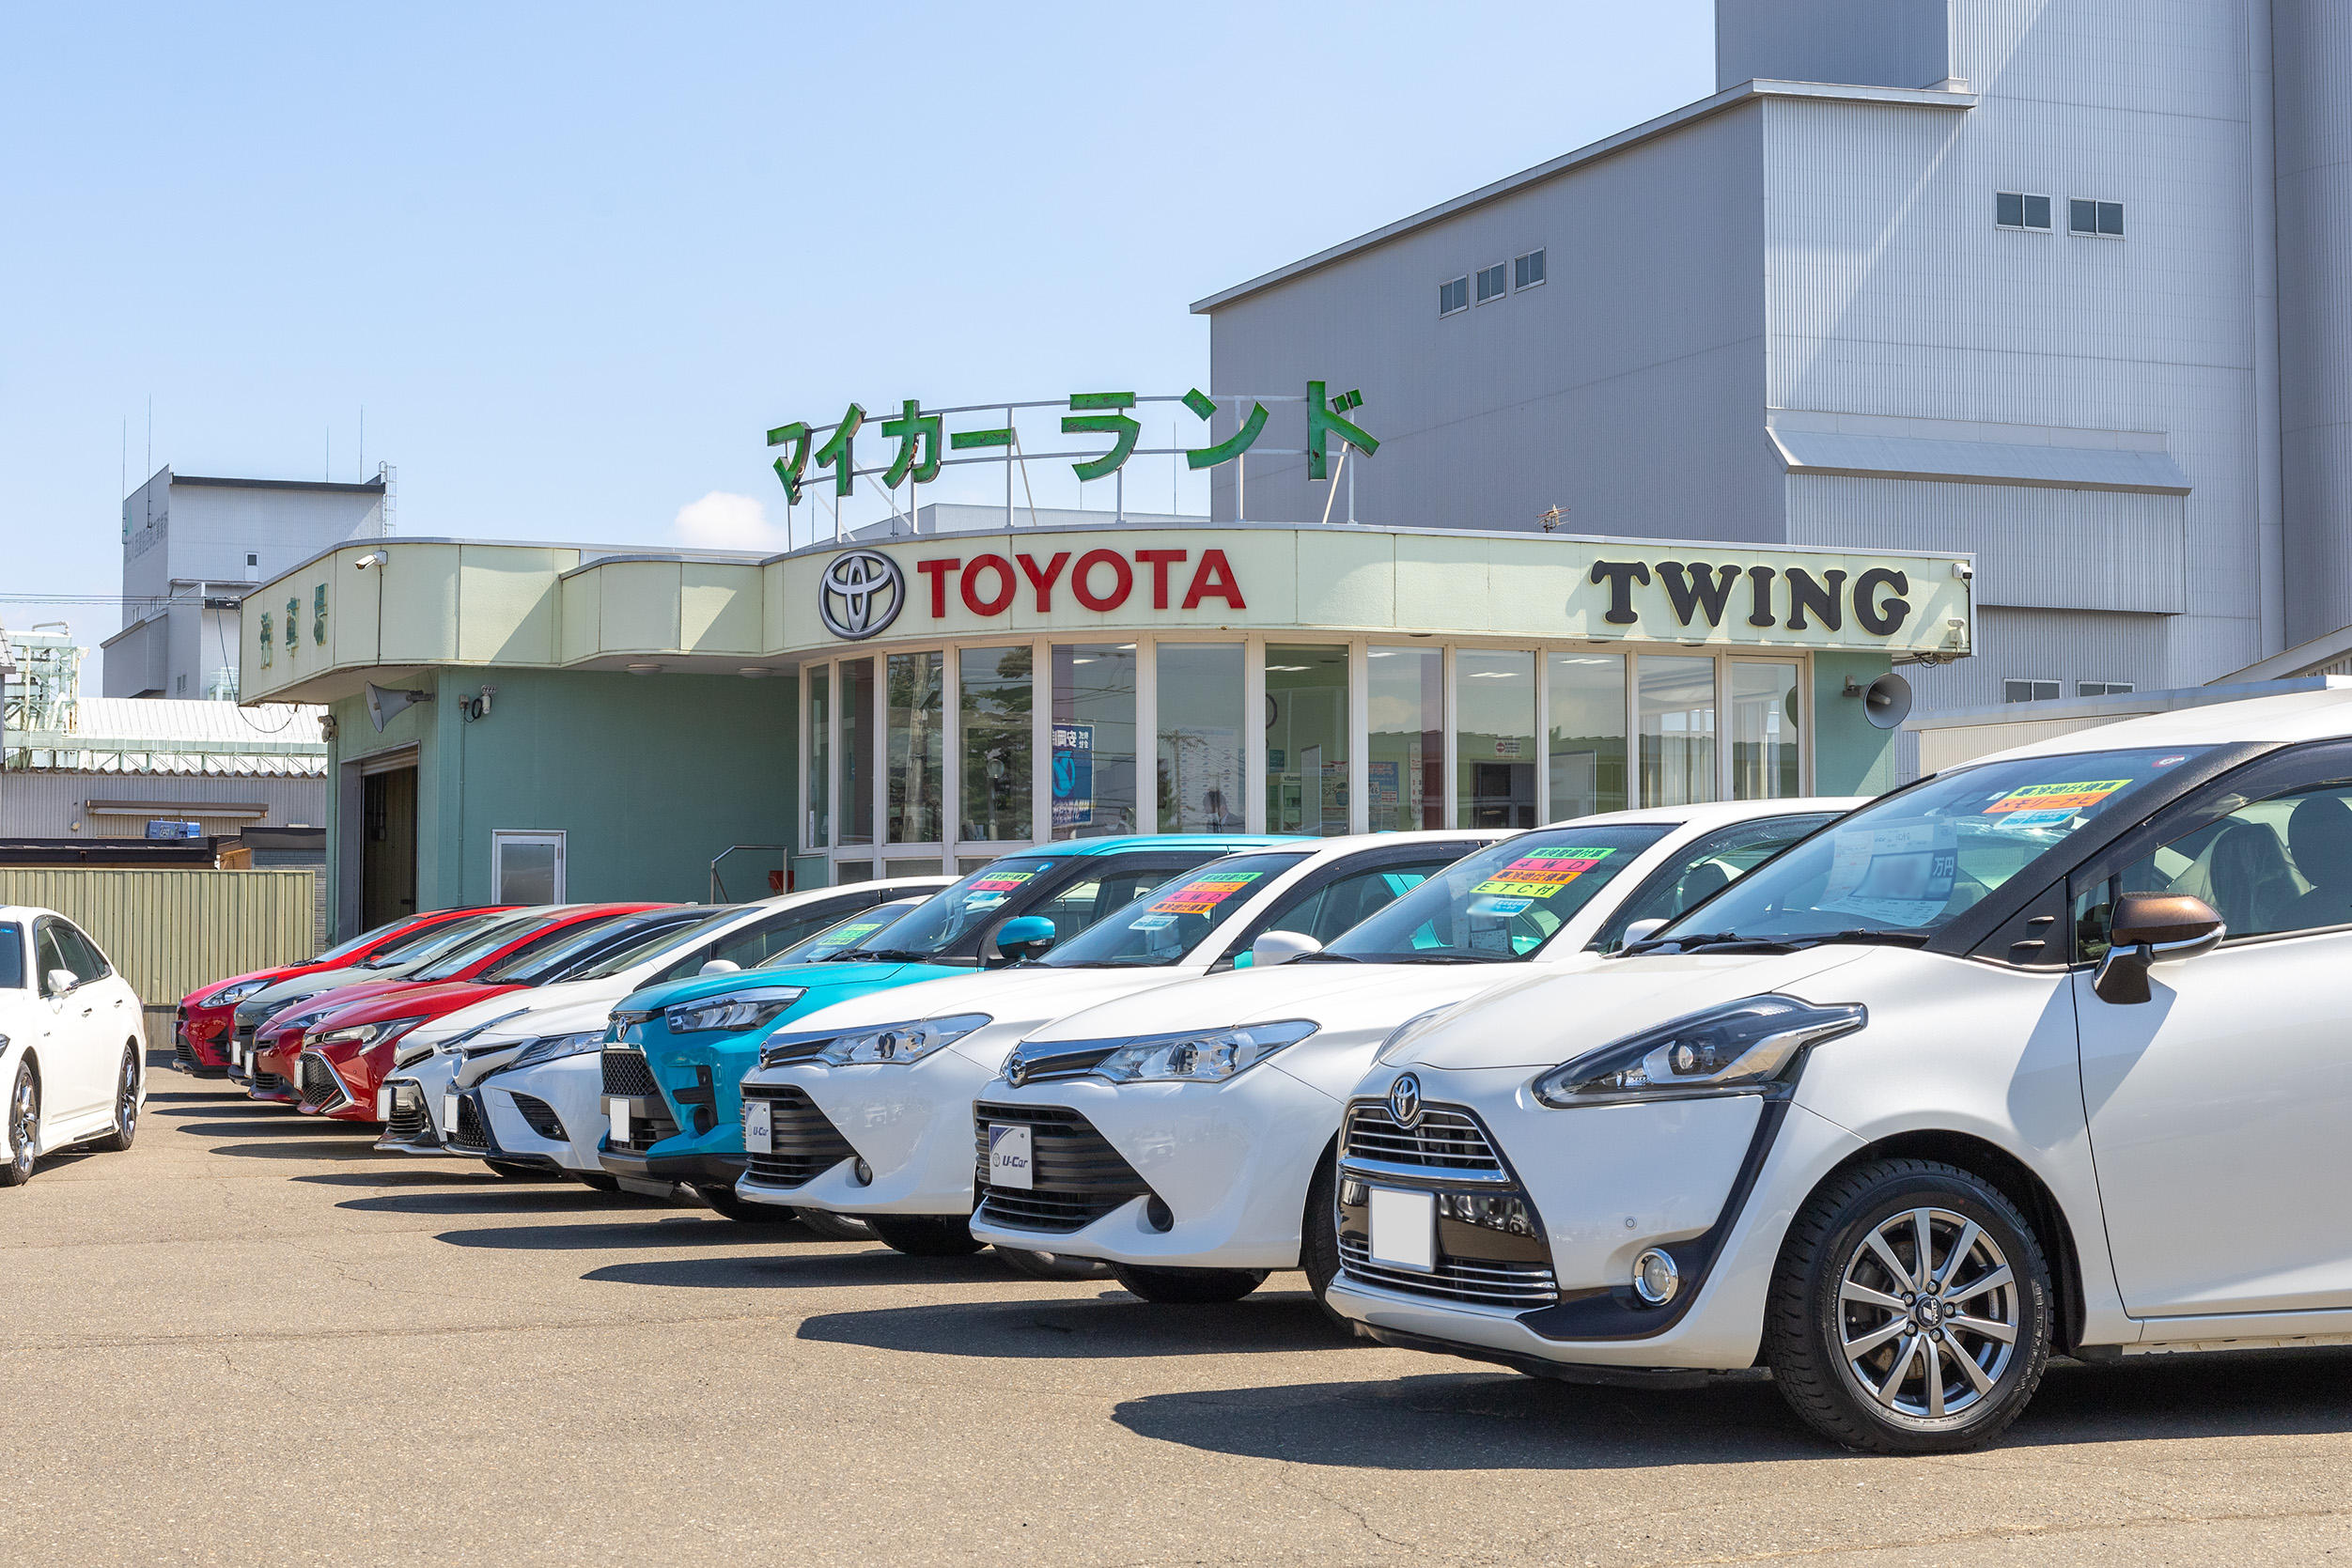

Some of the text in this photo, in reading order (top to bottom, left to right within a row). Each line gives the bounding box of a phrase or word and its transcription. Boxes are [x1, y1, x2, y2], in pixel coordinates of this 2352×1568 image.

[767, 380, 1380, 505] マイカーランド
[916, 548, 1247, 618] TOYOTA
[1590, 560, 1911, 637] TWING
[1994, 793, 2099, 810] メモリーナビ
[1518, 860, 1585, 870] 4WD
[1932, 856, 1955, 877] 万円
[1476, 882, 1555, 895] ETC付
